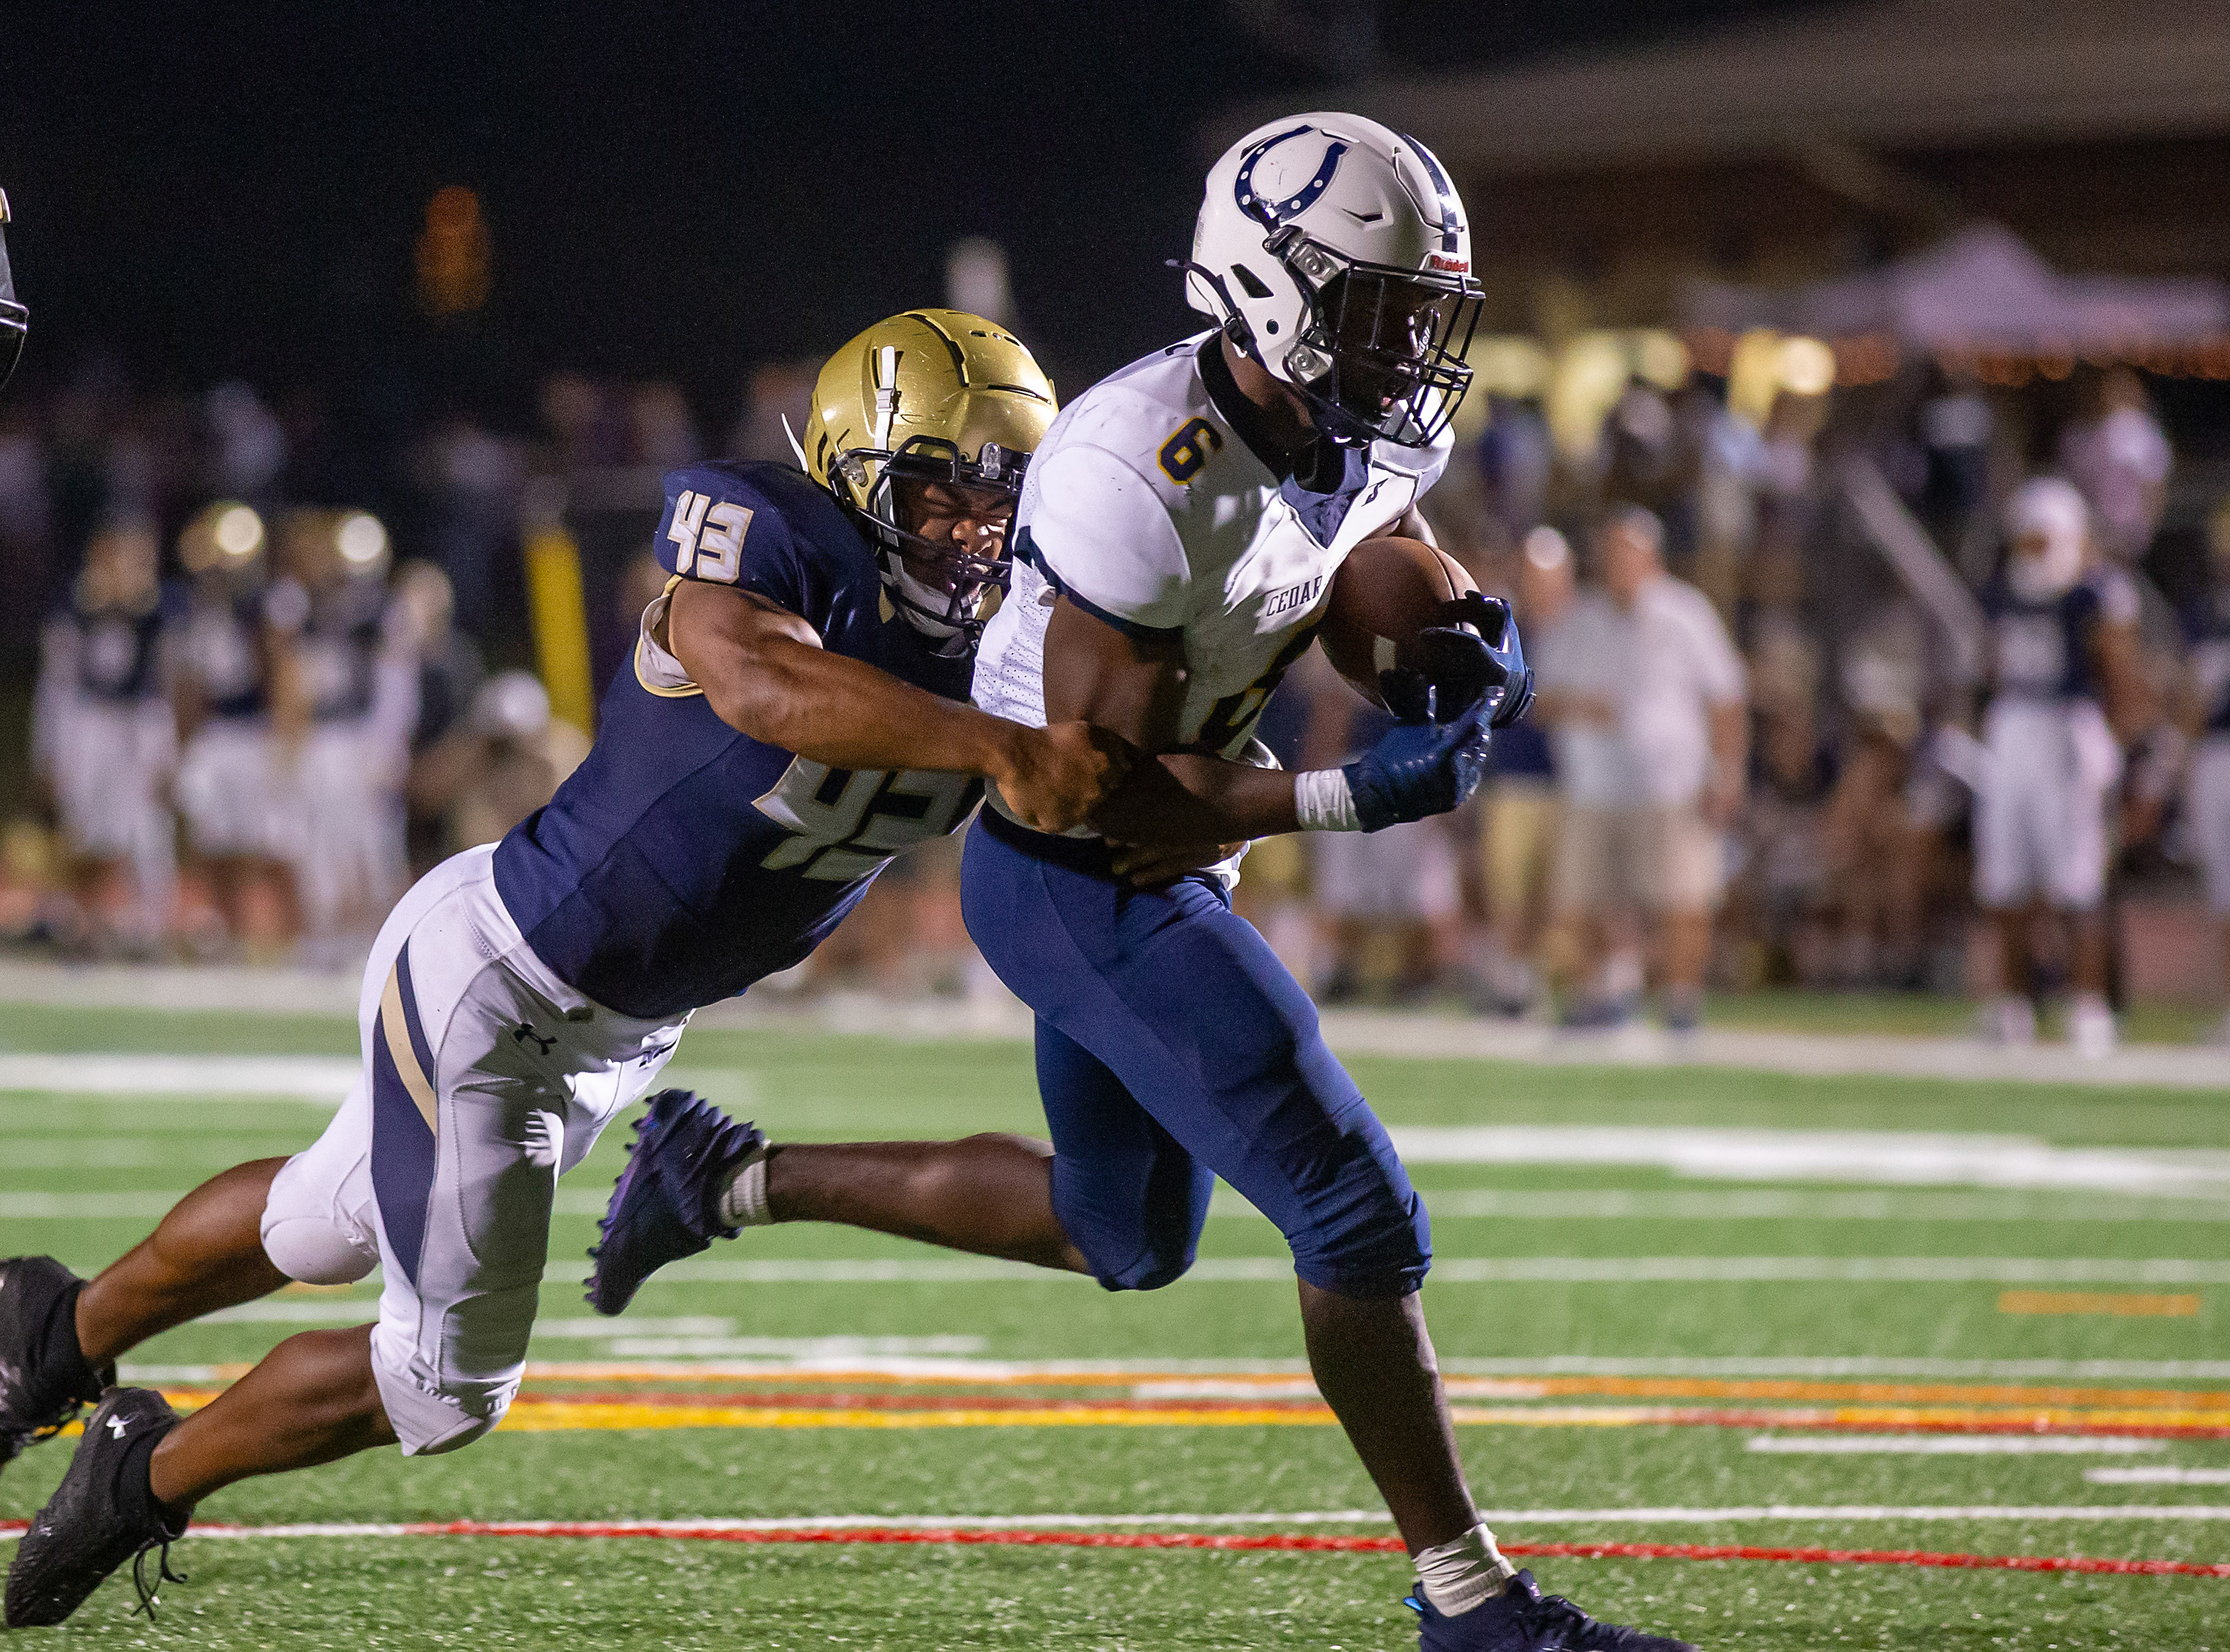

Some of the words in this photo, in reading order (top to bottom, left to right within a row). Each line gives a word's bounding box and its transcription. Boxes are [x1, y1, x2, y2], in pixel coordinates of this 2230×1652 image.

[1157, 416, 1225, 485] 6
[667, 489, 755, 584] 43
[1266, 575, 1323, 616] CEDAR
